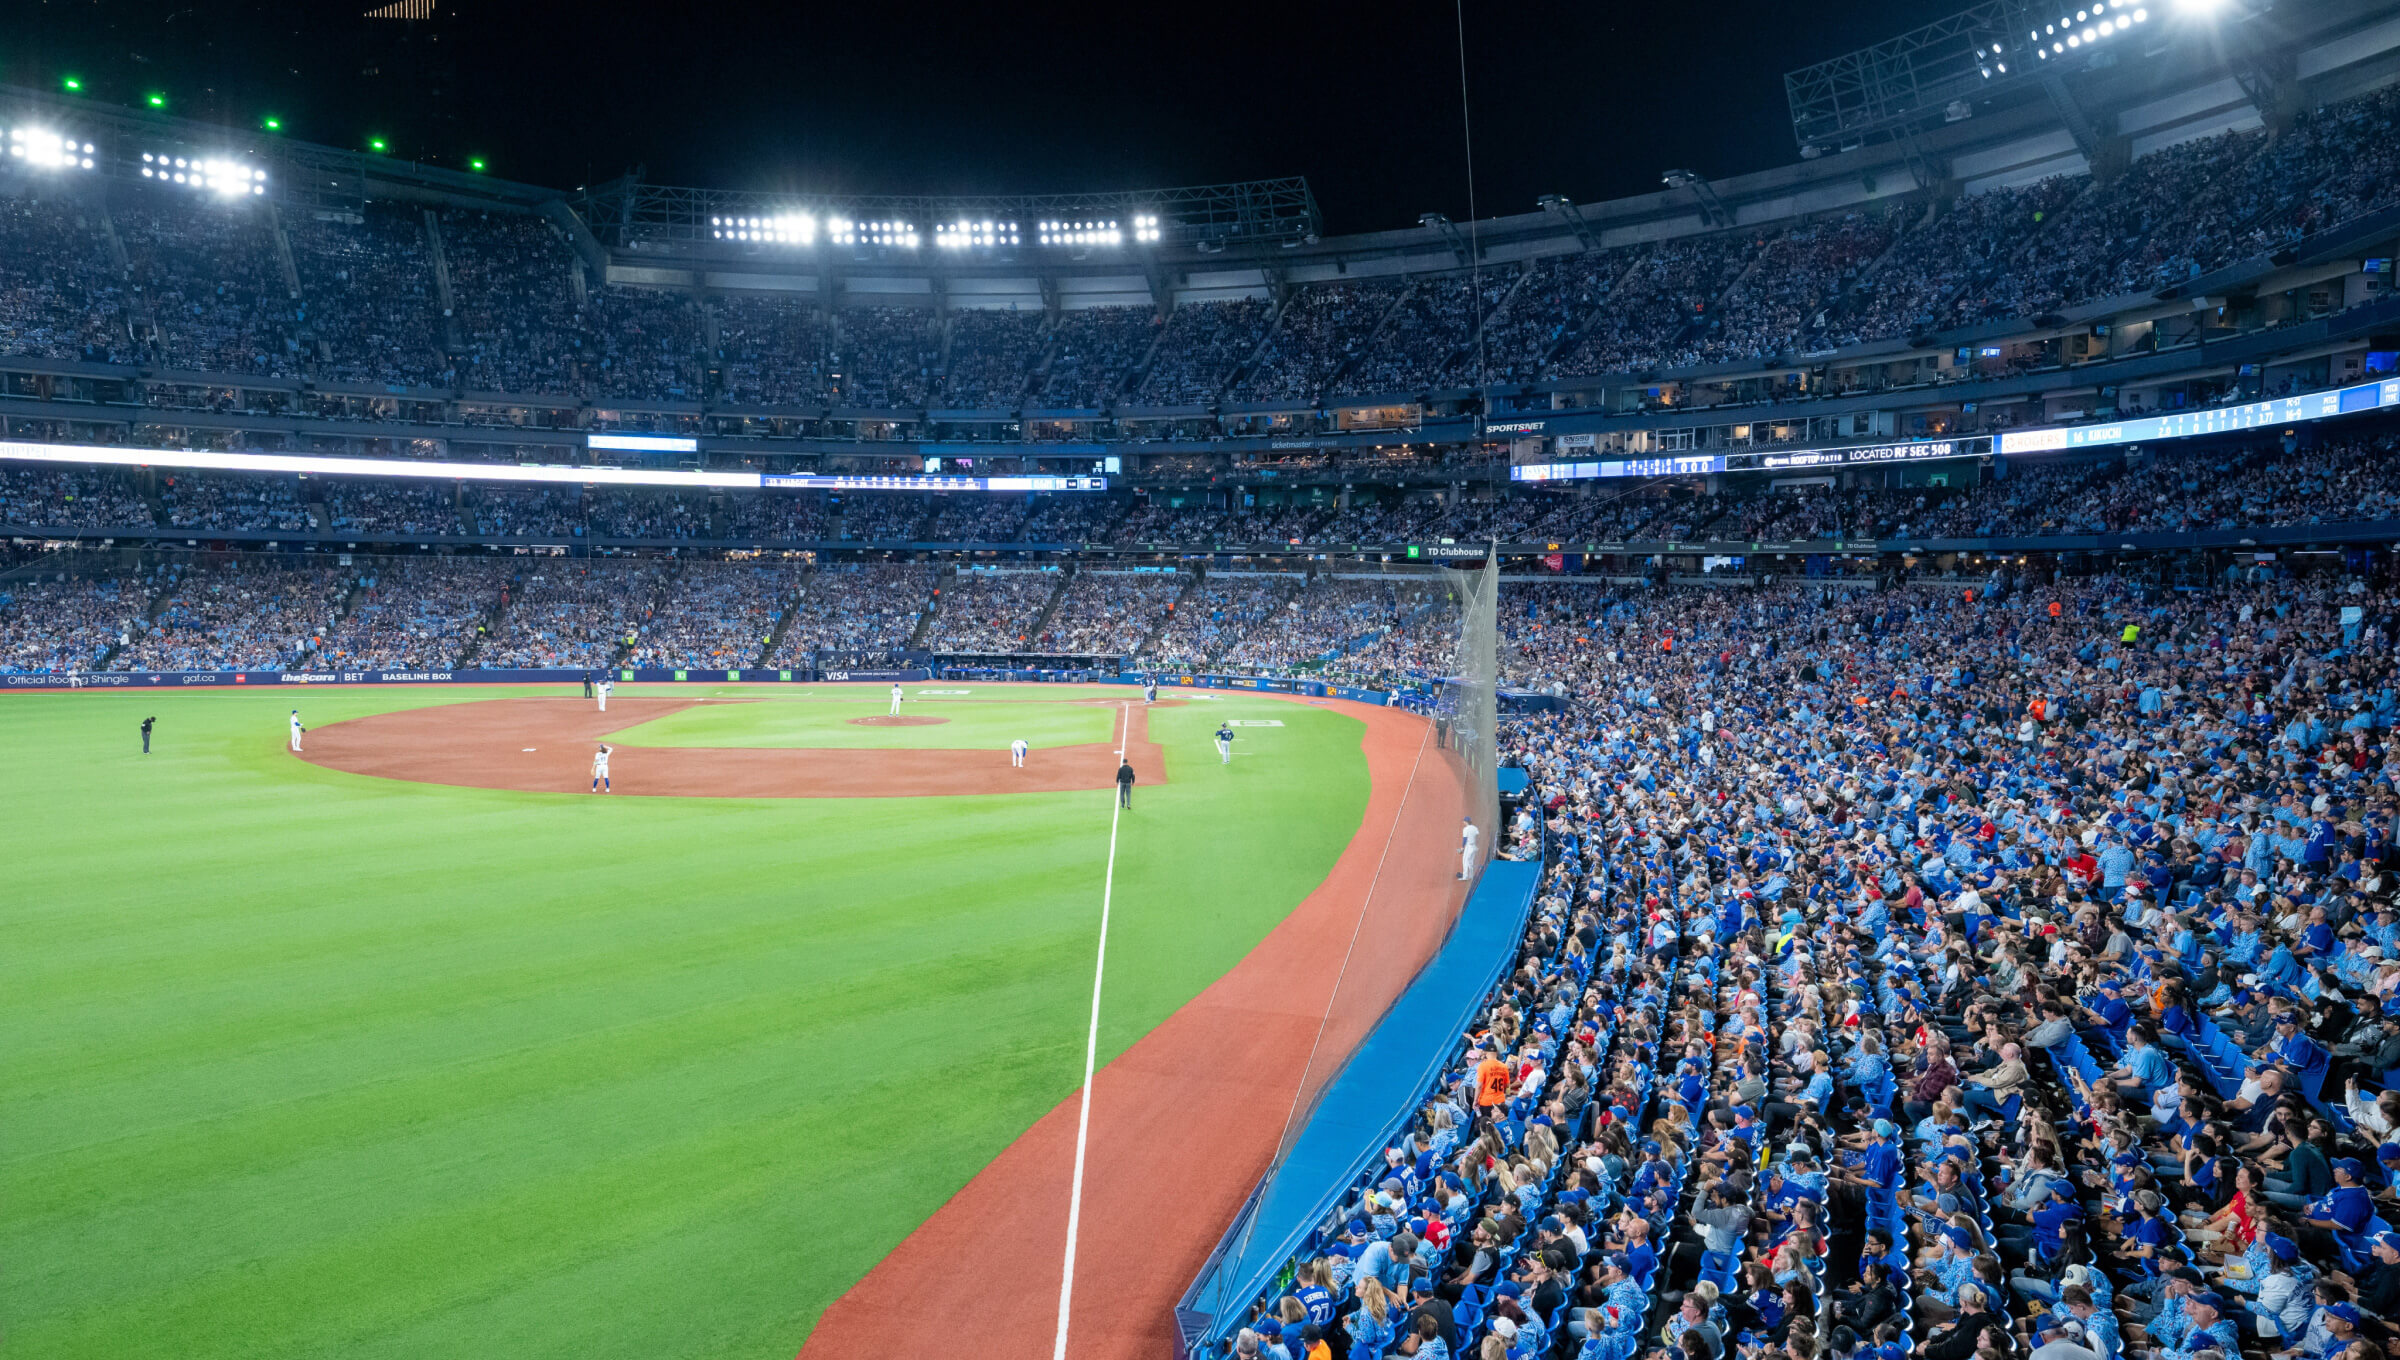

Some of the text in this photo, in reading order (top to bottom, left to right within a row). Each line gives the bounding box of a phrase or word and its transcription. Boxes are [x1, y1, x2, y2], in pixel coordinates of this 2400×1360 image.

[1486, 421, 1546, 433] SPORTSNET
[2073, 426, 2122, 443] 16 KIKUCHI
[1271, 440, 1311, 449] ticketmaster
[2017, 433, 2060, 447] ROGERS
[1850, 443, 1951, 460] LOCATED RF SEC 508
[1820, 454, 1842, 463] PATIO
[1680, 461, 1708, 473] 0 0 0
[1409, 547, 1418, 556] TD
[1427, 547, 1484, 556] TD Clubhouse
[8, 674, 129, 685] Official Roog Shingle
[183, 674, 216, 684] gaf.ca
[281, 673, 364, 682] theScore BET
[382, 672, 452, 681] BASELINE BOX
[825, 671, 849, 681] VISA
[1310, 1302, 1330, 1326] 27
